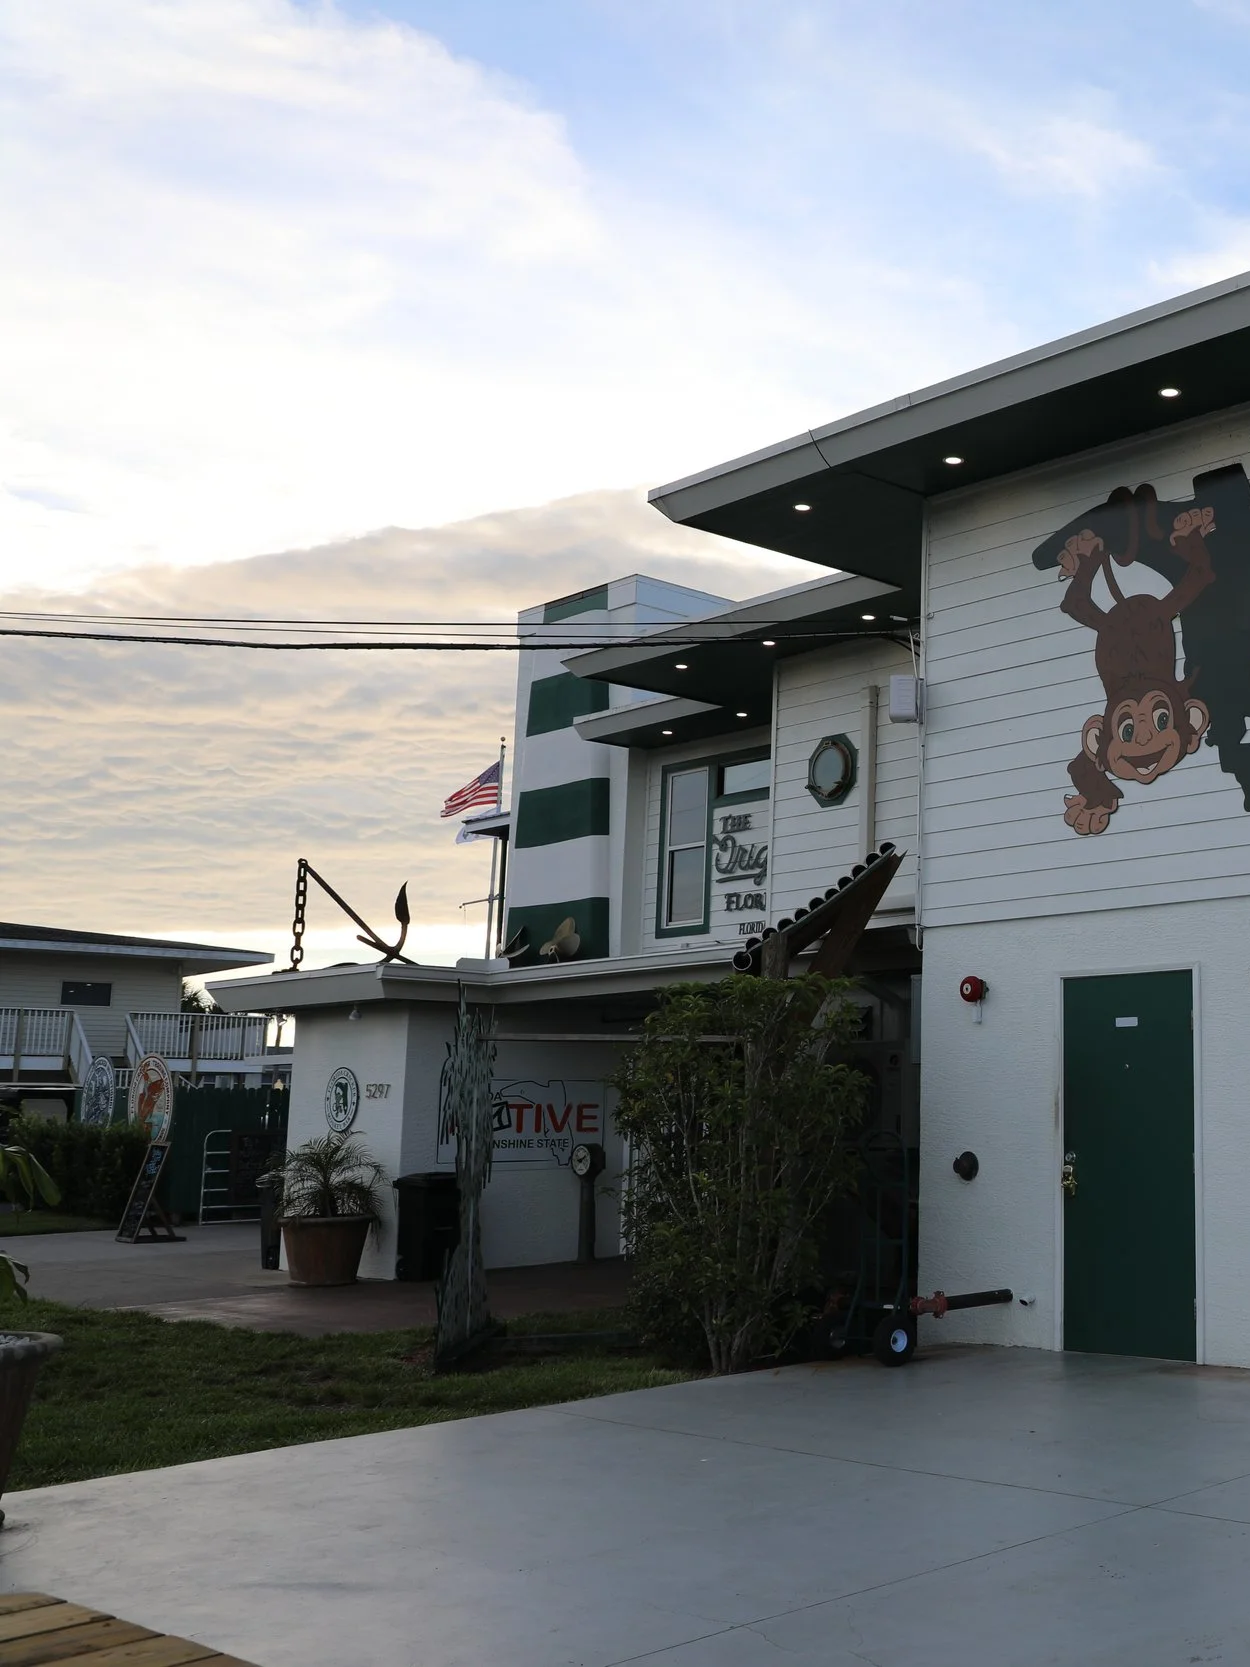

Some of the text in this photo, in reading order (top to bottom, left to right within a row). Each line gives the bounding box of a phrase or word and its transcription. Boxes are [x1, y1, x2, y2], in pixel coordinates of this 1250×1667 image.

[719, 814, 752, 834] THE
[712, 835, 768, 885] Orig
[725, 892, 767, 912] FLOR
[365, 1083, 392, 1099] 5297
[492, 1102, 600, 1133] TIVE
[492, 1138, 569, 1149] NSHINE STATE
